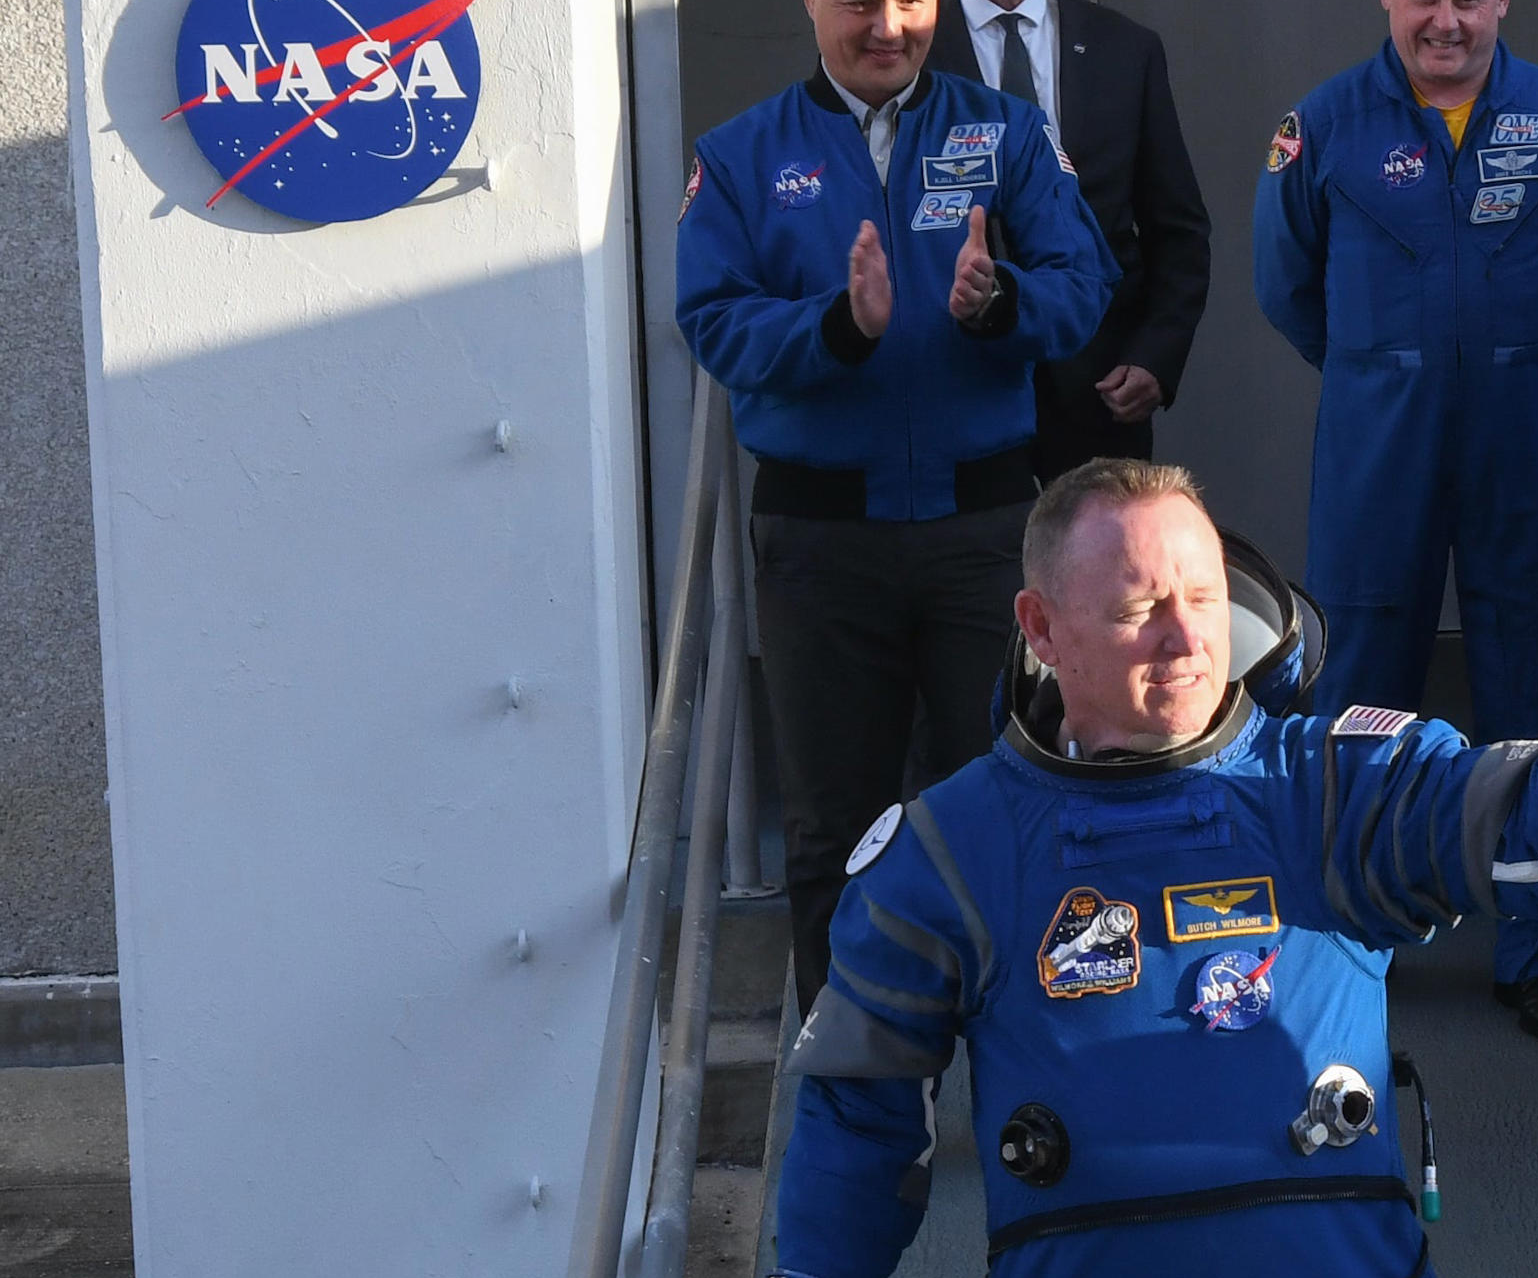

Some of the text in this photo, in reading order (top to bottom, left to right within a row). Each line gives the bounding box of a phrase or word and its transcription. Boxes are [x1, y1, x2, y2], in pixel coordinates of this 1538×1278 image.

[200, 39, 467, 104] NASA
[1384, 158, 1424, 174] NASA
[776, 176, 822, 192] NASA
[920, 196, 962, 224] 25
[1477, 188, 1516, 218] 25
[1187, 917, 1262, 933] BUTCH WILMORE
[1202, 976, 1271, 1003] NASA
